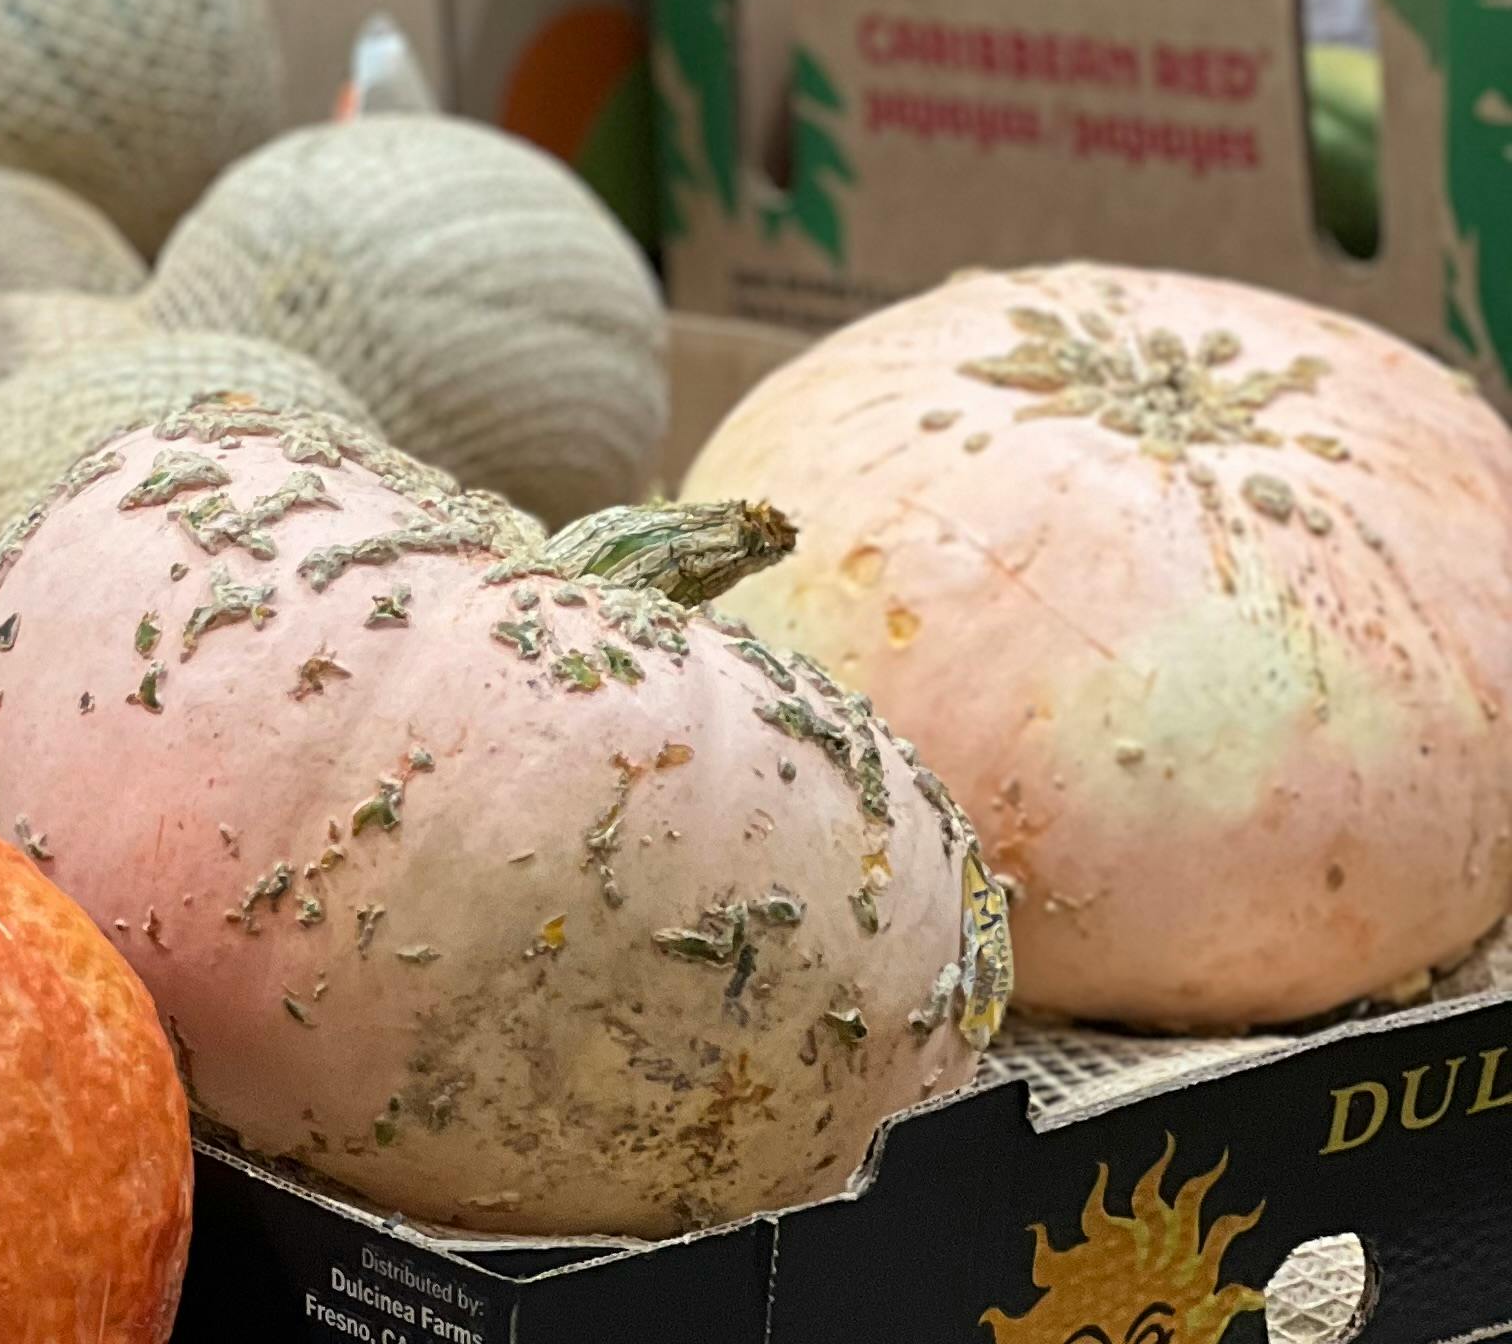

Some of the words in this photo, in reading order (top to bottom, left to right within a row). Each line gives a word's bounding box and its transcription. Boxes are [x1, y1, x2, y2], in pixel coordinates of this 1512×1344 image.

[857, 12, 1142, 89] CARIBBEAN
[331, 1267, 415, 1325] Dulcinea
[362, 1247, 453, 1304] Distributed
[457, 1287, 484, 1317] by:
